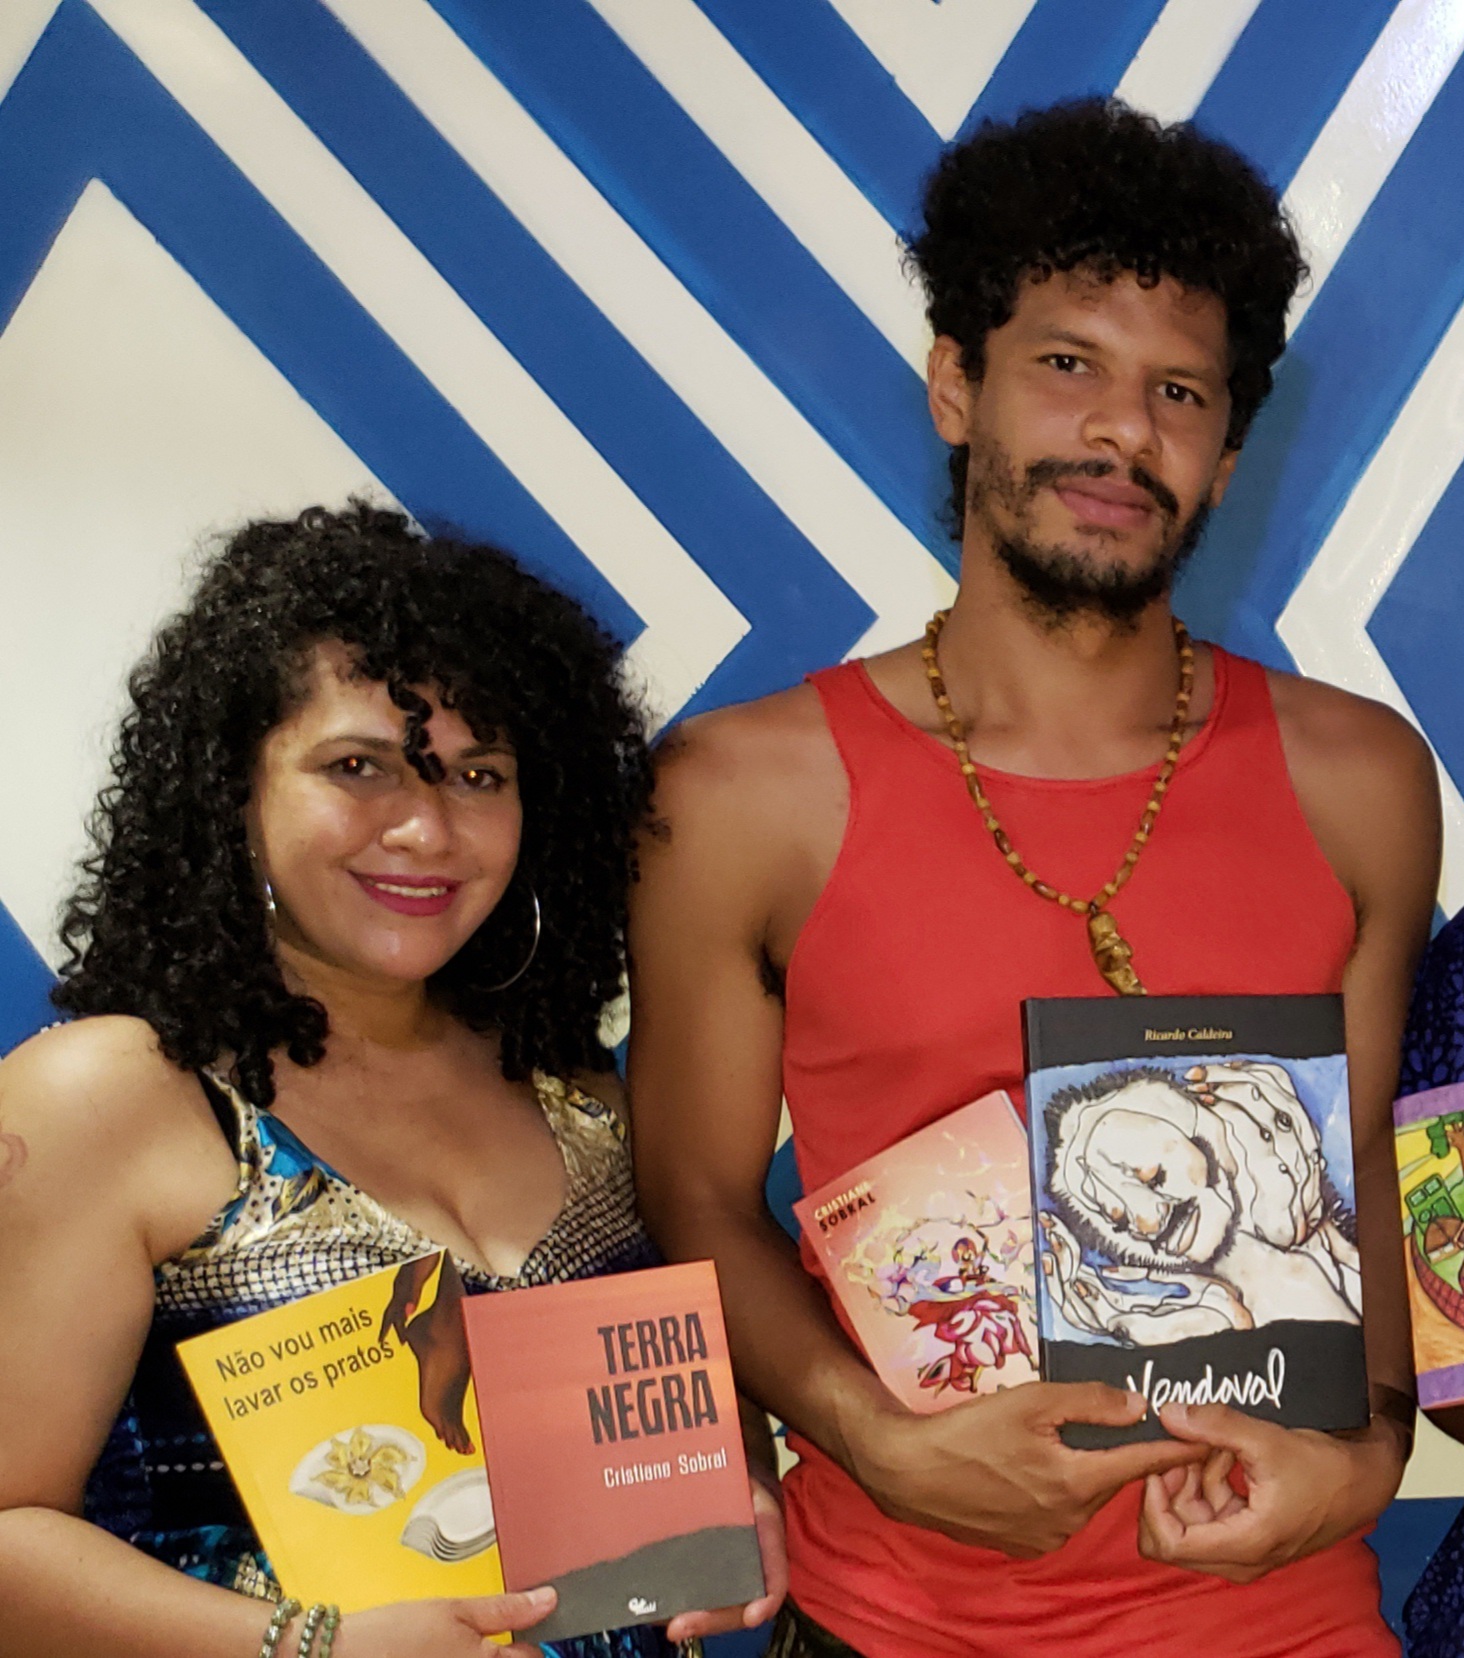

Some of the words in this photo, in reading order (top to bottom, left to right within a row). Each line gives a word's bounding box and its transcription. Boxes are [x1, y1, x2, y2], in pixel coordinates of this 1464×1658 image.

[1144, 1027, 1186, 1042] Ricardo
[1187, 1026, 1233, 1041] Caldeira
[214, 1350, 265, 1383] Não
[269, 1330, 315, 1361] vou
[319, 1306, 373, 1345] mais
[597, 1311, 709, 1375] TERRA
[224, 1381, 283, 1421] lavar
[290, 1370, 319, 1395] os
[323, 1340, 395, 1389] pratos
[586, 1369, 719, 1445] NEGRA
[678, 1446, 727, 1475] Sobral
